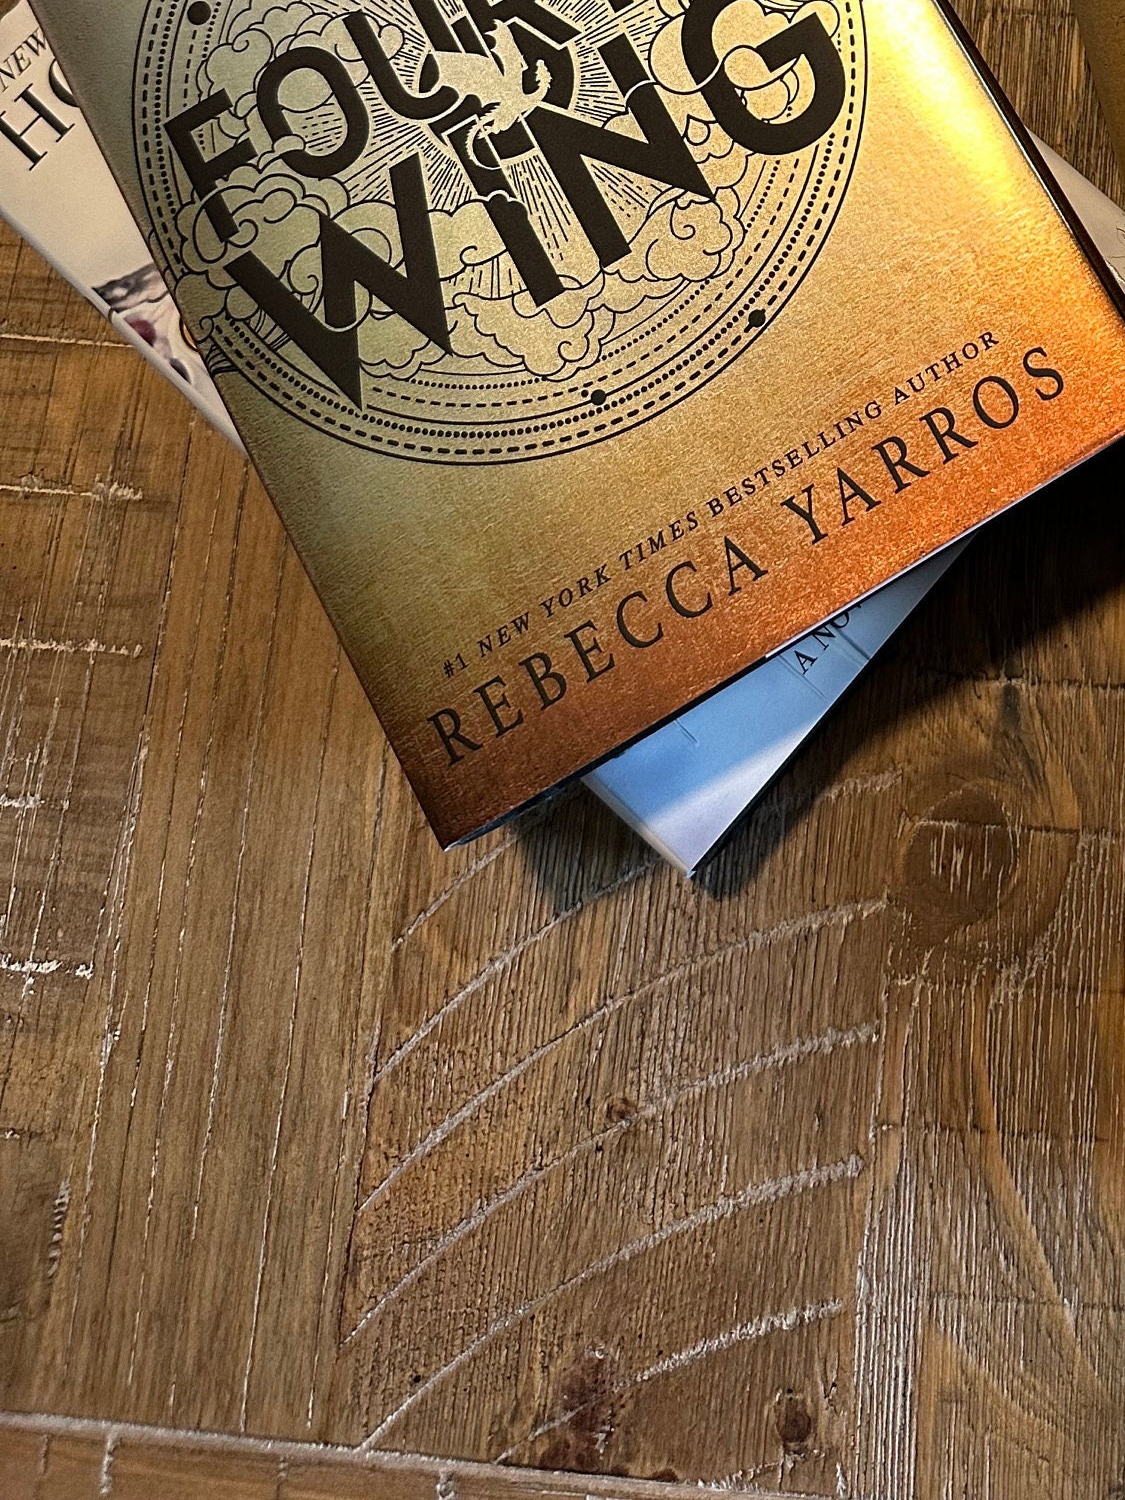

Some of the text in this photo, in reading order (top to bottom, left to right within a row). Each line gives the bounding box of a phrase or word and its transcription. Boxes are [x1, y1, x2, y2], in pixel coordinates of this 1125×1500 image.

[427, 346, 1066, 768] REBECCA YARROS
[442, 329, 1001, 679] #1 NEW YORK TIMES BESTSELLING AUTHOR
[793, 603, 862, 675] A NO
